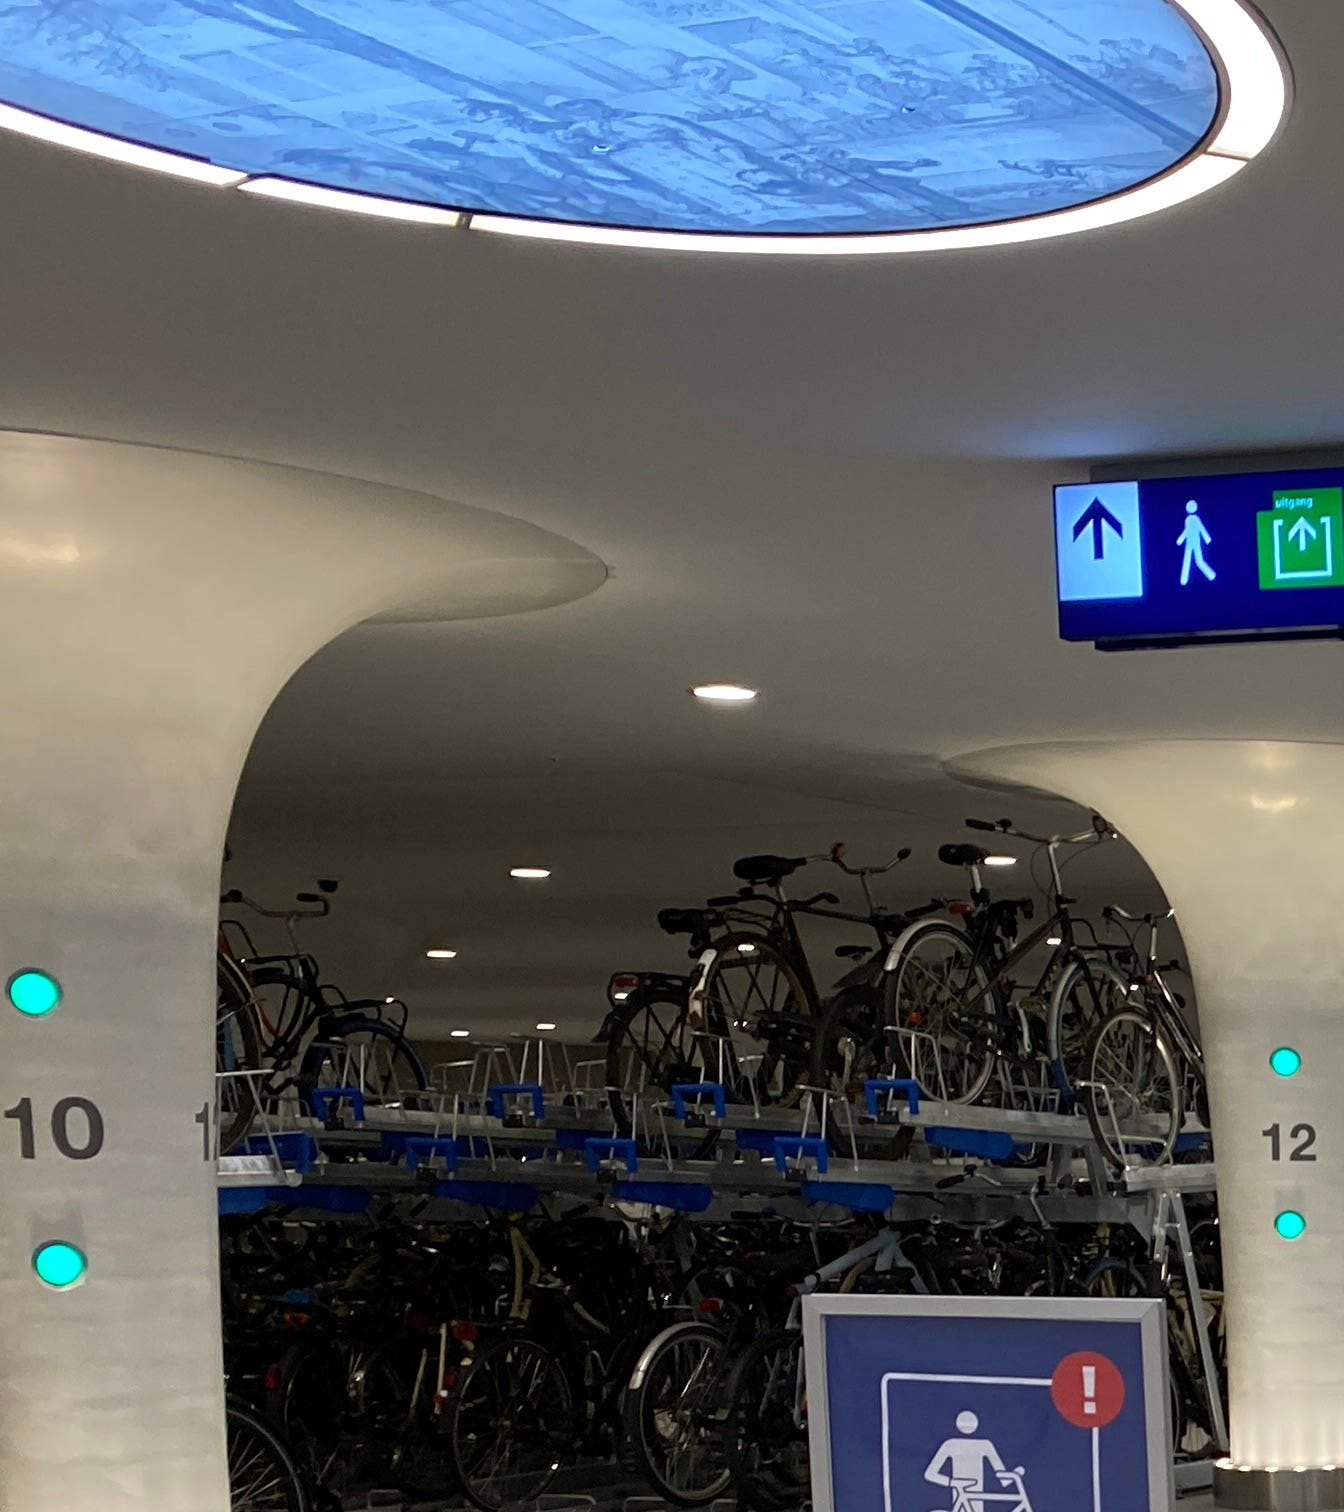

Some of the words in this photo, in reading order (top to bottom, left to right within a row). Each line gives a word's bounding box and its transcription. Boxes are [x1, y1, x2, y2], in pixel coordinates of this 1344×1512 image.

[1275, 497, 1313, 511] uitgang
[4, 1097, 104, 1160] 10
[195, 1102, 218, 1161] 1
[1262, 1123, 1317, 1161] 12
